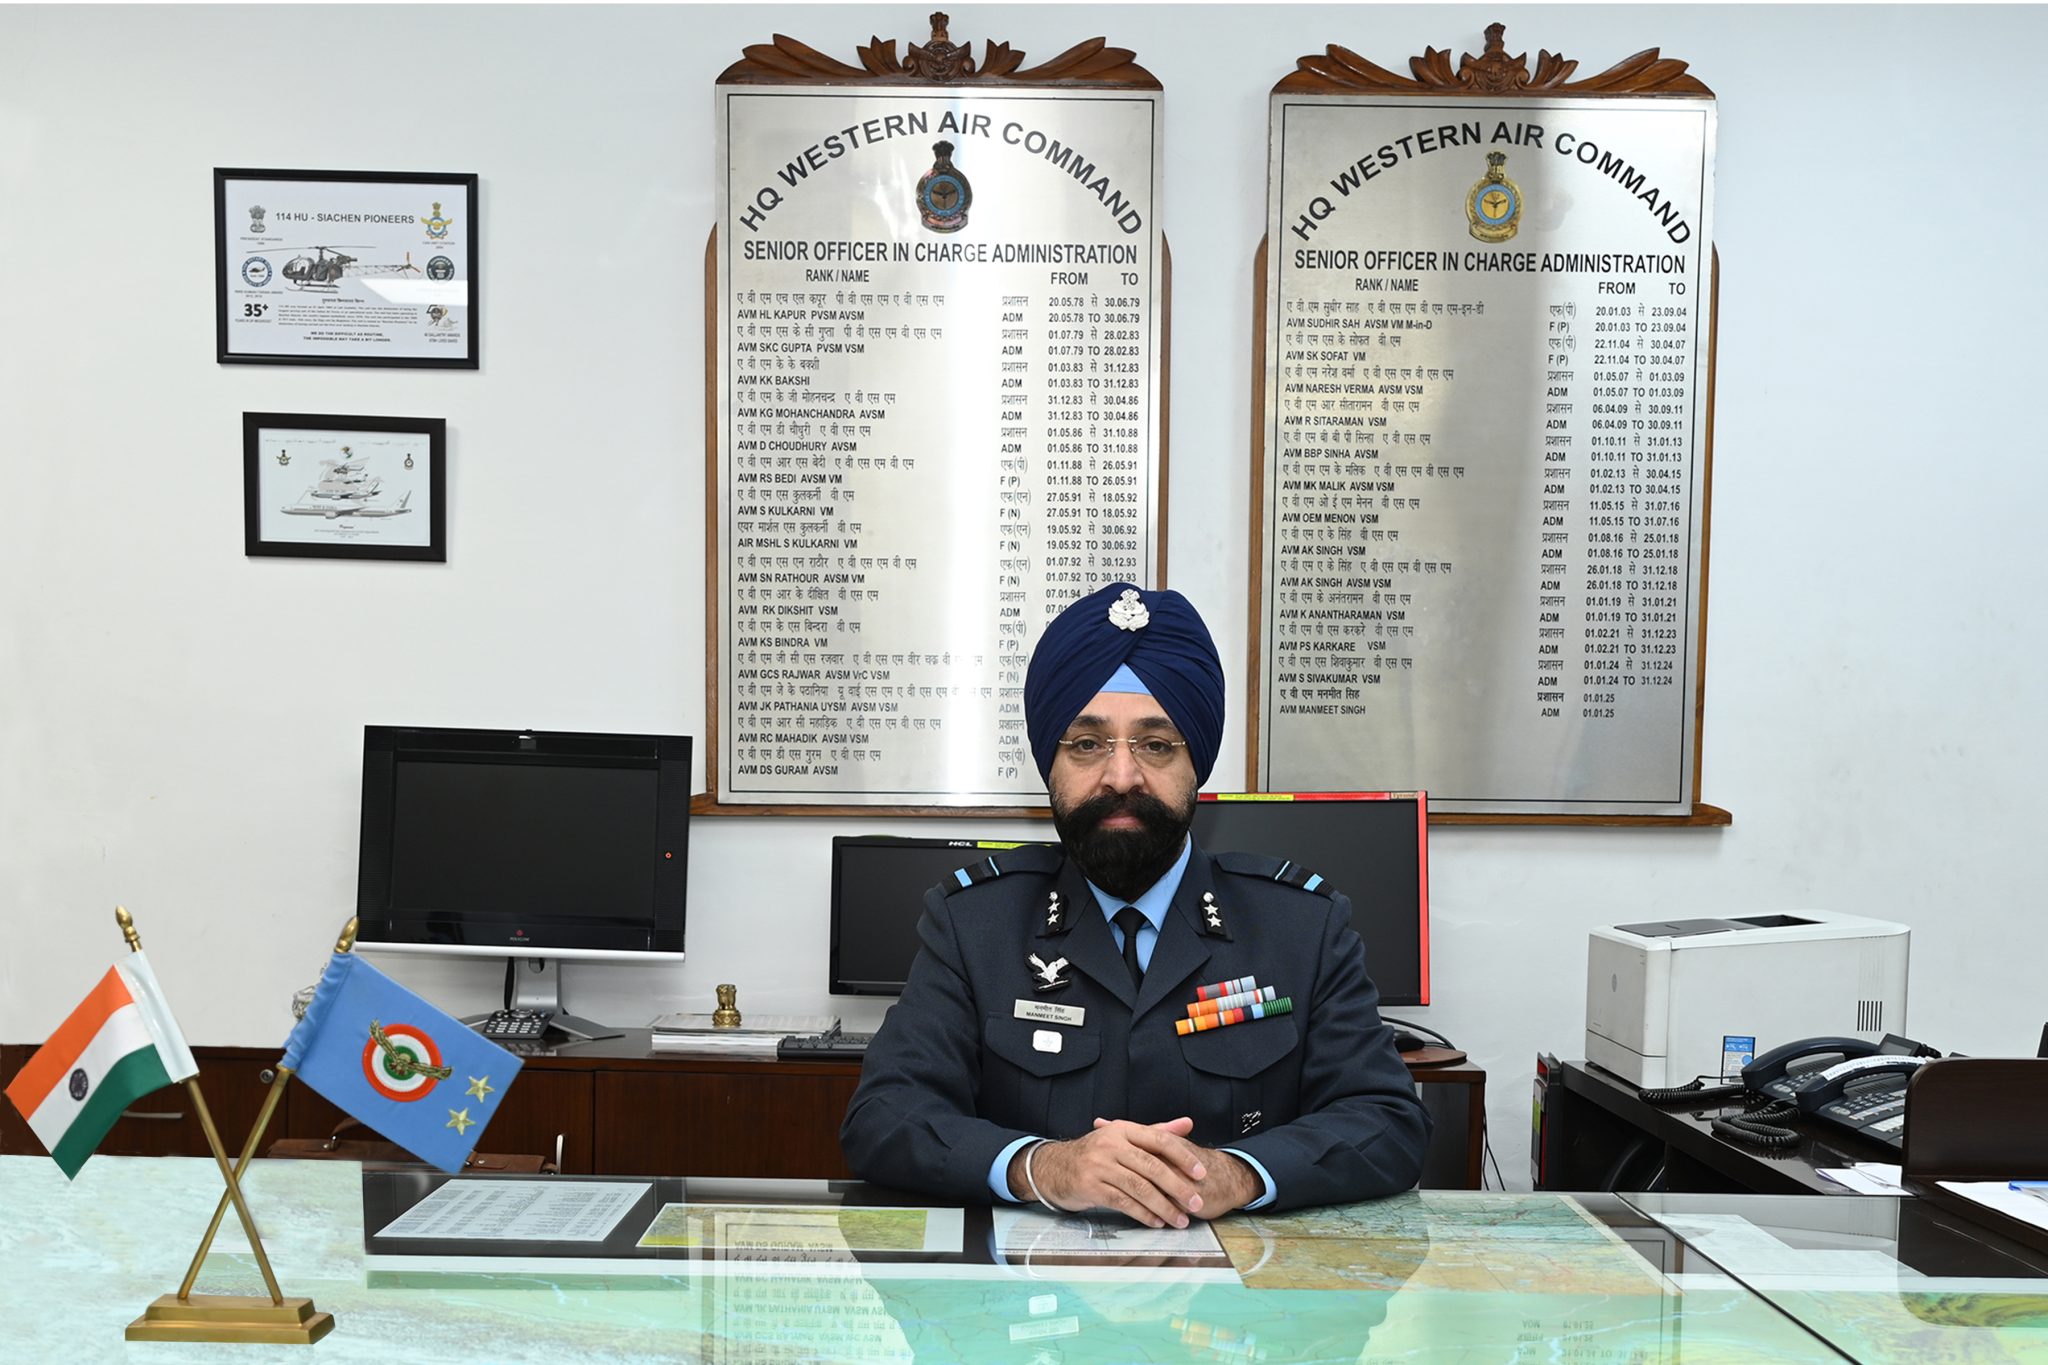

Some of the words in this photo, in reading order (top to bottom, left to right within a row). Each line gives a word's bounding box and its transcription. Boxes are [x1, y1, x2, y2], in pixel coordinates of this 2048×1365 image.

[739, 187, 784, 232] HQ
[777, 111, 928, 188] WESTERN
[937, 111, 992, 138] AIR
[1002, 122, 1142, 235] COMMAND
[1291, 196, 1336, 241] HQ
[1330, 121, 1481, 197] WESTERN
[1490, 121, 1545, 148] AIR
[1555, 133, 1691, 244] COMMAND
[275, 212, 291, 220] 114
[293, 212, 308, 221] HU
[316, 212, 361, 223] SIACHEN
[363, 214, 414, 224] PIONEERS
[743, 239, 808, 260] SENIOR
[813, 240, 888, 261] OFFICER
[893, 242, 909, 261] IN
[914, 242, 987, 262] CHARGE
[991, 243, 1136, 264] ADMINISTRATION
[1294, 249, 1358, 269] SENIOR
[1364, 250, 1437, 271] OFFICER
[1442, 251, 1458, 271] IN
[1464, 252, 1536, 272] CHARGE
[1540, 252, 1685, 274] ADMINISTRATION
[805, 268, 833, 282] RANK
[835, 269, 839, 281] /
[841, 269, 870, 282] NAME
[1050, 271, 1088, 285] FROM
[1120, 272, 1138, 286] TO
[1355, 278, 1383, 291] RANK
[1384, 278, 1389, 291] /
[1390, 278, 1419, 291] NAME
[1598, 281, 1635, 294] FROM
[1668, 282, 1685, 295] TO
[1048, 296, 1084, 307] 20.05.78
[1104, 297, 1140, 307] 30.06.79
[736, 309, 757, 319] AVM
[759, 309, 772, 319] HL
[773, 309, 806, 320] KAPUR
[810, 310, 837, 320] PVSM
[838, 310, 864, 320] AVSM
[1001, 312, 1023, 322] ADM
[1048, 312, 1084, 322] 20.05.78
[1087, 312, 1101, 323] TO
[1104, 312, 1140, 323] 30.06.79
[1286, 318, 1305, 327] AVM
[1306, 318, 1340, 328] SUDHIR
[1341, 318, 1360, 328] SAH
[1363, 318, 1388, 329] AVSM
[1390, 319, 1404, 329] VM
[1405, 319, 1432, 330] M-in-D
[1549, 322, 1555, 331] F
[1557, 322, 1569, 333] (P)
[1595, 321, 1630, 332] 20.01.03
[1634, 322, 1647, 332] TO
[1650, 322, 1686, 332] 23.09.04
[737, 342, 757, 352] AVM
[759, 342, 778, 352] SKC
[780, 342, 812, 353] GUPTA
[816, 343, 842, 353] PVSM
[844, 343, 864, 353] VSM
[737, 375, 757, 385] AVM
[759, 375, 773, 385] KK
[775, 375, 810, 386] BAKSHI
[1284, 383, 1303, 393] AVM
[1305, 383, 1341, 393] NARESH
[1343, 383, 1375, 394] VERMA
[1377, 384, 1402, 394] AVSM
[1404, 384, 1423, 394] VSM
[736, 408, 757, 417] AVM
[759, 408, 773, 418] KG
[775, 408, 855, 419] MOHANCHANDRA
[858, 408, 885, 419] AVSM
[737, 440, 757, 450] AVM
[759, 440, 766, 450] D
[768, 440, 827, 451] CHOUDHURY
[830, 441, 857, 451] AVSM
[737, 505, 757, 515] AVM
[759, 505, 766, 515] S
[767, 505, 815, 516] KULKARNI
[819, 506, 833, 516] VM
[999, 508, 1005, 517] F
[1007, 508, 1020, 519] (N)
[1046, 508, 1081, 517] 27.05.91
[1085, 508, 1098, 518] TO
[1102, 508, 1137, 518] 18.05.92
[1281, 512, 1300, 522] AVM
[1302, 512, 1322, 523] OEM
[1323, 512, 1355, 523] MENON
[1359, 513, 1378, 524] VSM
[1589, 516, 1624, 526] 11.05.15
[1627, 516, 1641, 526] TO
[1643, 516, 1679, 526] 31.07.16
[737, 538, 753, 547] AIR
[755, 538, 781, 548] MSHL
[783, 538, 790, 548] S
[791, 538, 839, 549] KULKARNI
[843, 539, 857, 548] VM
[1279, 609, 1298, 619] AVM
[1300, 609, 1306, 619] K
[1308, 609, 1382, 621] ANANTHARAMAN
[1386, 610, 1405, 620] VSM
[1539, 612, 1559, 622] ADM
[1585, 611, 1620, 622] 01.01.19
[1624, 611, 1637, 622] TO
[1641, 612, 1676, 622] 31.01.21
[737, 669, 757, 681] AVM
[759, 669, 781, 681] GCS
[781, 669, 820, 681] RAJWAR
[824, 669, 850, 680] AVSM
[852, 670, 868, 681] VrC
[869, 670, 890, 680] VSM
[737, 701, 757, 712] AVM
[759, 701, 771, 711] JK
[773, 701, 819, 712] PATHANIA
[820, 701, 846, 712] UYSM
[850, 702, 876, 712] AVSM
[878, 702, 897, 712] VSM
[1279, 704, 1297, 714] AVM
[1298, 704, 1338, 715] MANMEET
[1340, 704, 1366, 715] SINGH
[1540, 707, 1559, 717] ADM
[1582, 707, 1614, 718] 01.01.25
[737, 765, 757, 774] AVM
[759, 765, 772, 775] DS
[774, 765, 808, 775] GURAM
[812, 765, 838, 775] AVSM
